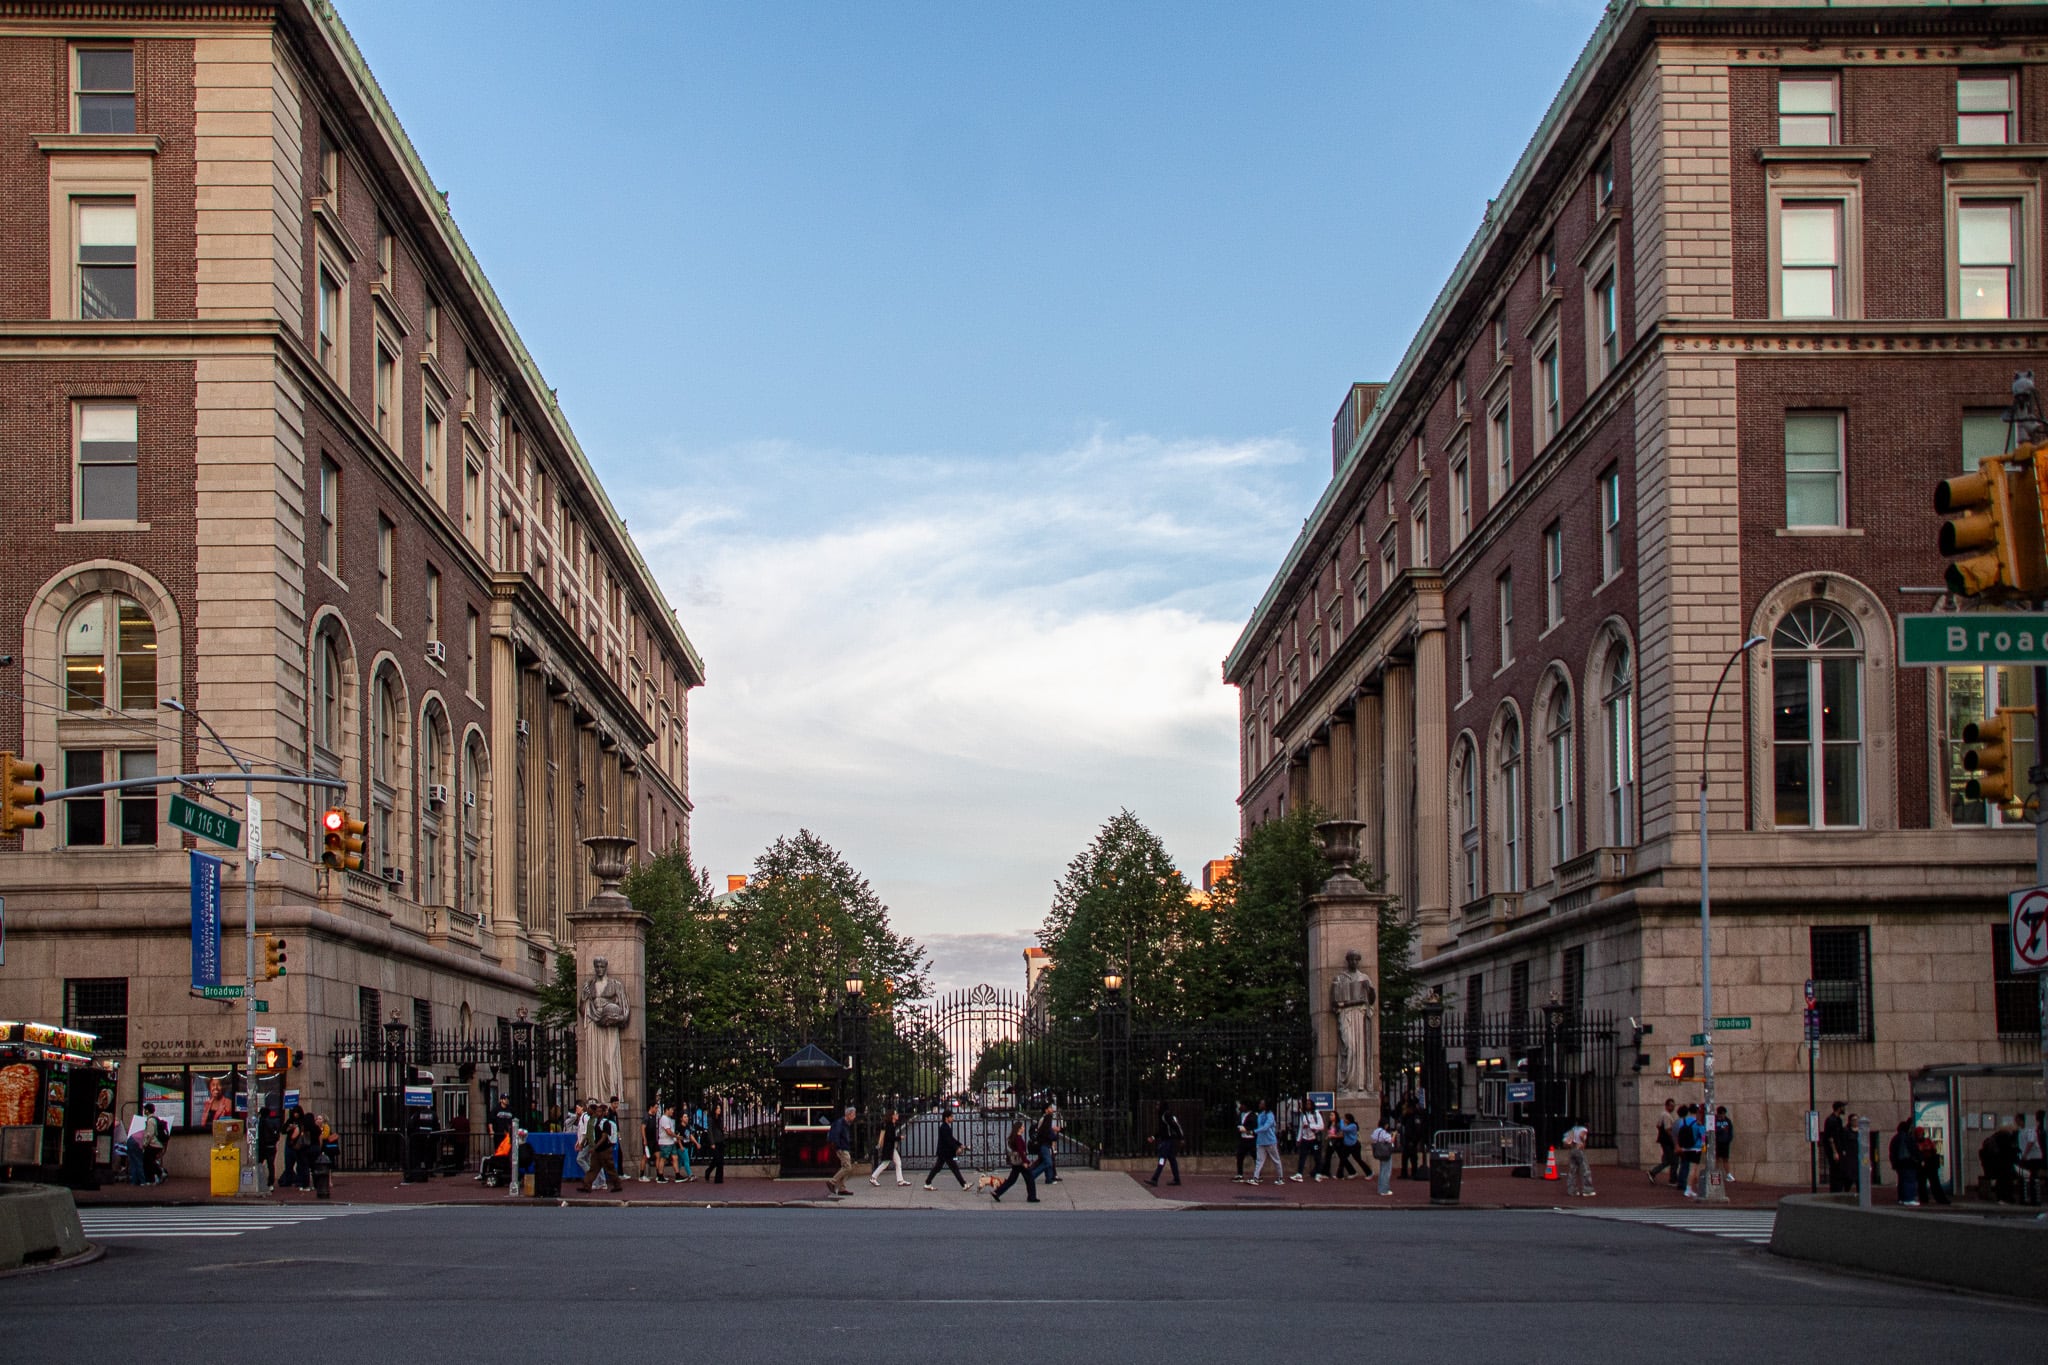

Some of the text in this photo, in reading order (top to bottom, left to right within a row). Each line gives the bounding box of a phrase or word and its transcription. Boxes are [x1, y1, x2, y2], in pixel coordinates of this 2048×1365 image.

[184, 806, 227, 839] W 116 St
[249, 823, 260, 843] 25
[204, 986, 244, 998] Broadway
[1714, 1019, 1750, 1029] Broadway
[142, 1040, 205, 1049] COLUMBIA
